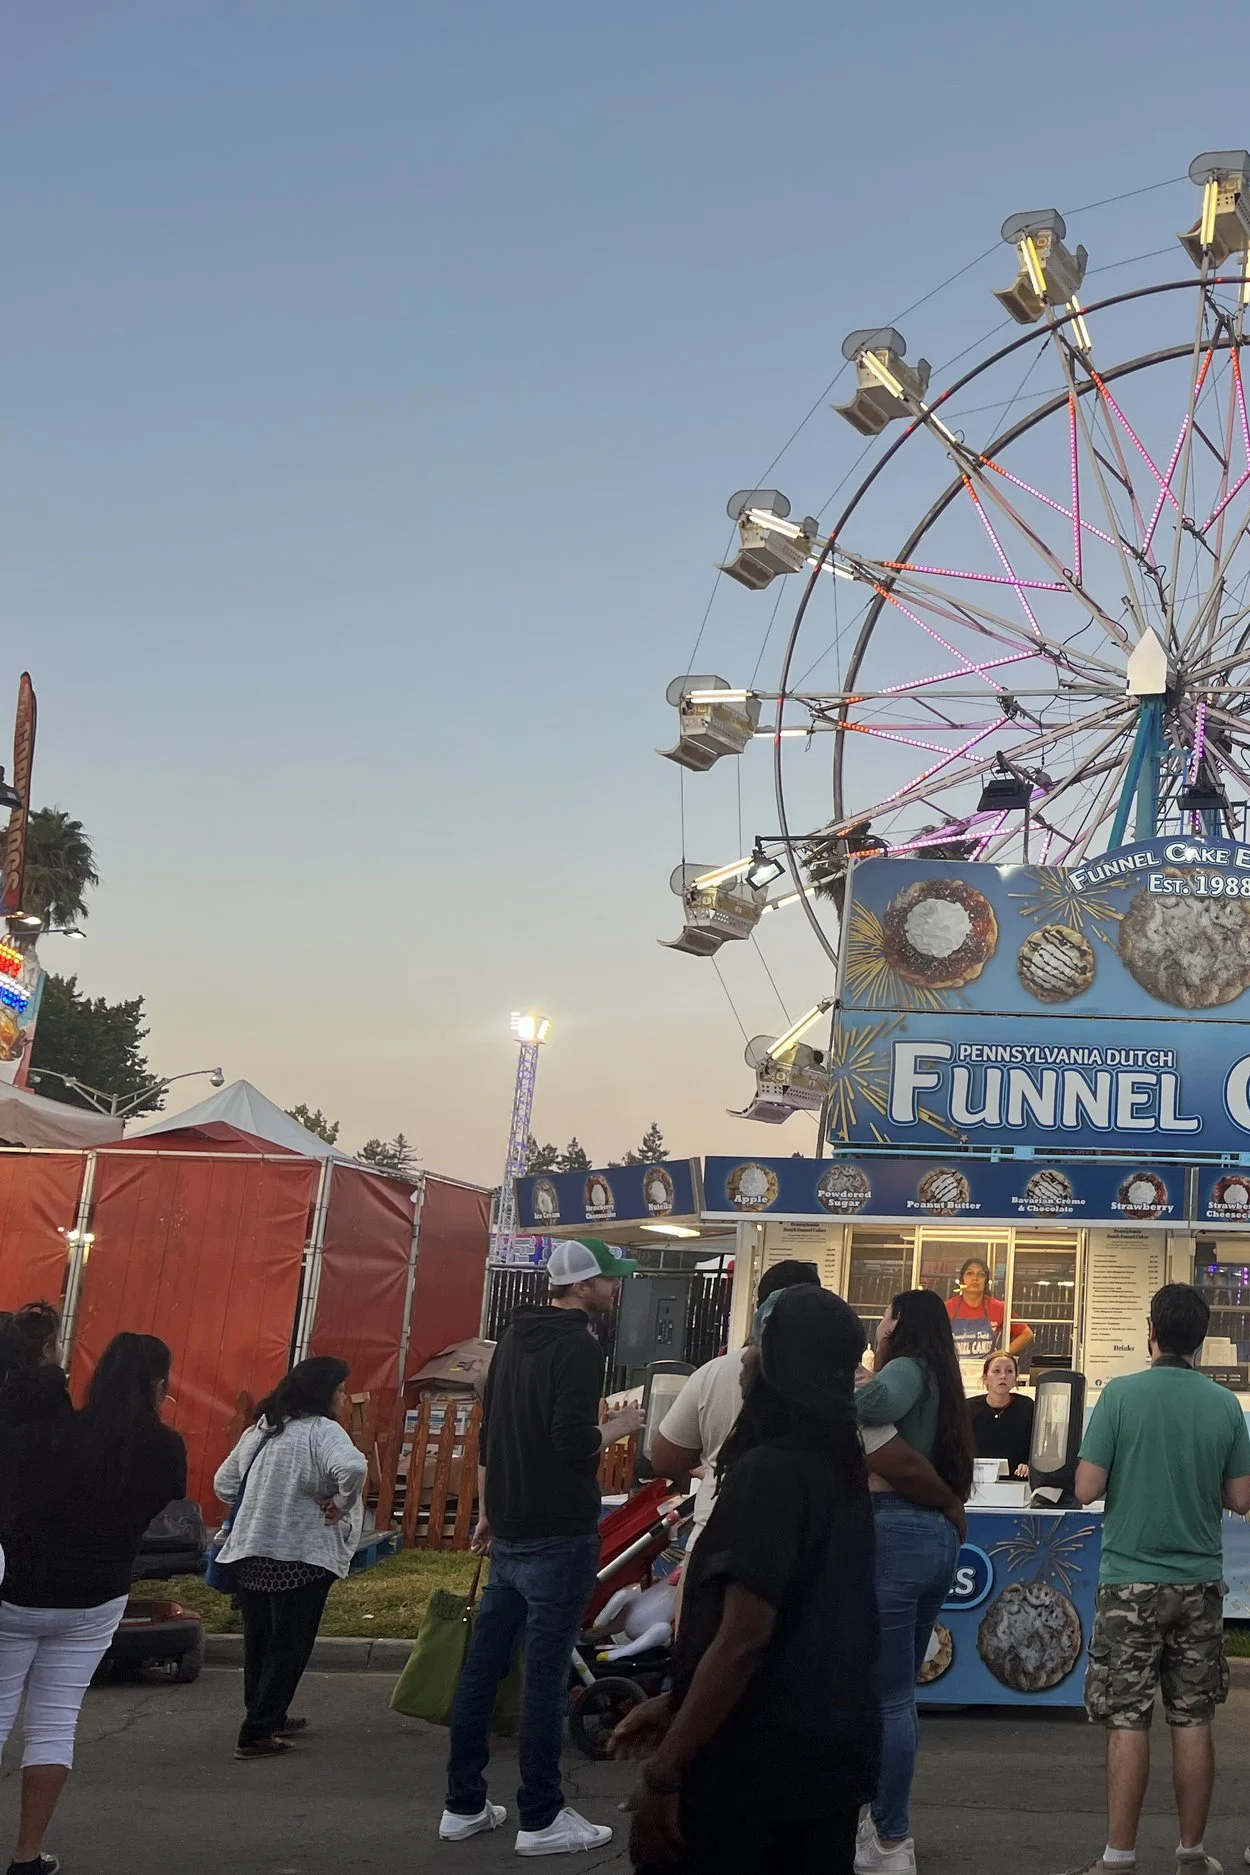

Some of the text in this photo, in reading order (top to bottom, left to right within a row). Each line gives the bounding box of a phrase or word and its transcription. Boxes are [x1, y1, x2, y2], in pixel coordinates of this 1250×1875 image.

[1068, 852, 1160, 892] FUNNEL
[1165, 842, 1229, 865] CAKE
[959, 1044, 1174, 1067] PENNSYLVANIA DUTCH
[890, 1040, 1200, 1132] FUNNEL
[733, 1194, 769, 1205] Apple
[817, 1190, 872, 1199] Powdered
[828, 1199, 861, 1208] Sugar
[906, 1200, 981, 1210] Peanut Butter
[1011, 1196, 1054, 1205] Bavarian
[648, 1202, 673, 1211] Nutella
[1026, 1205, 1074, 1213] Chocolate
[1110, 1202, 1175, 1213] Strawberry
